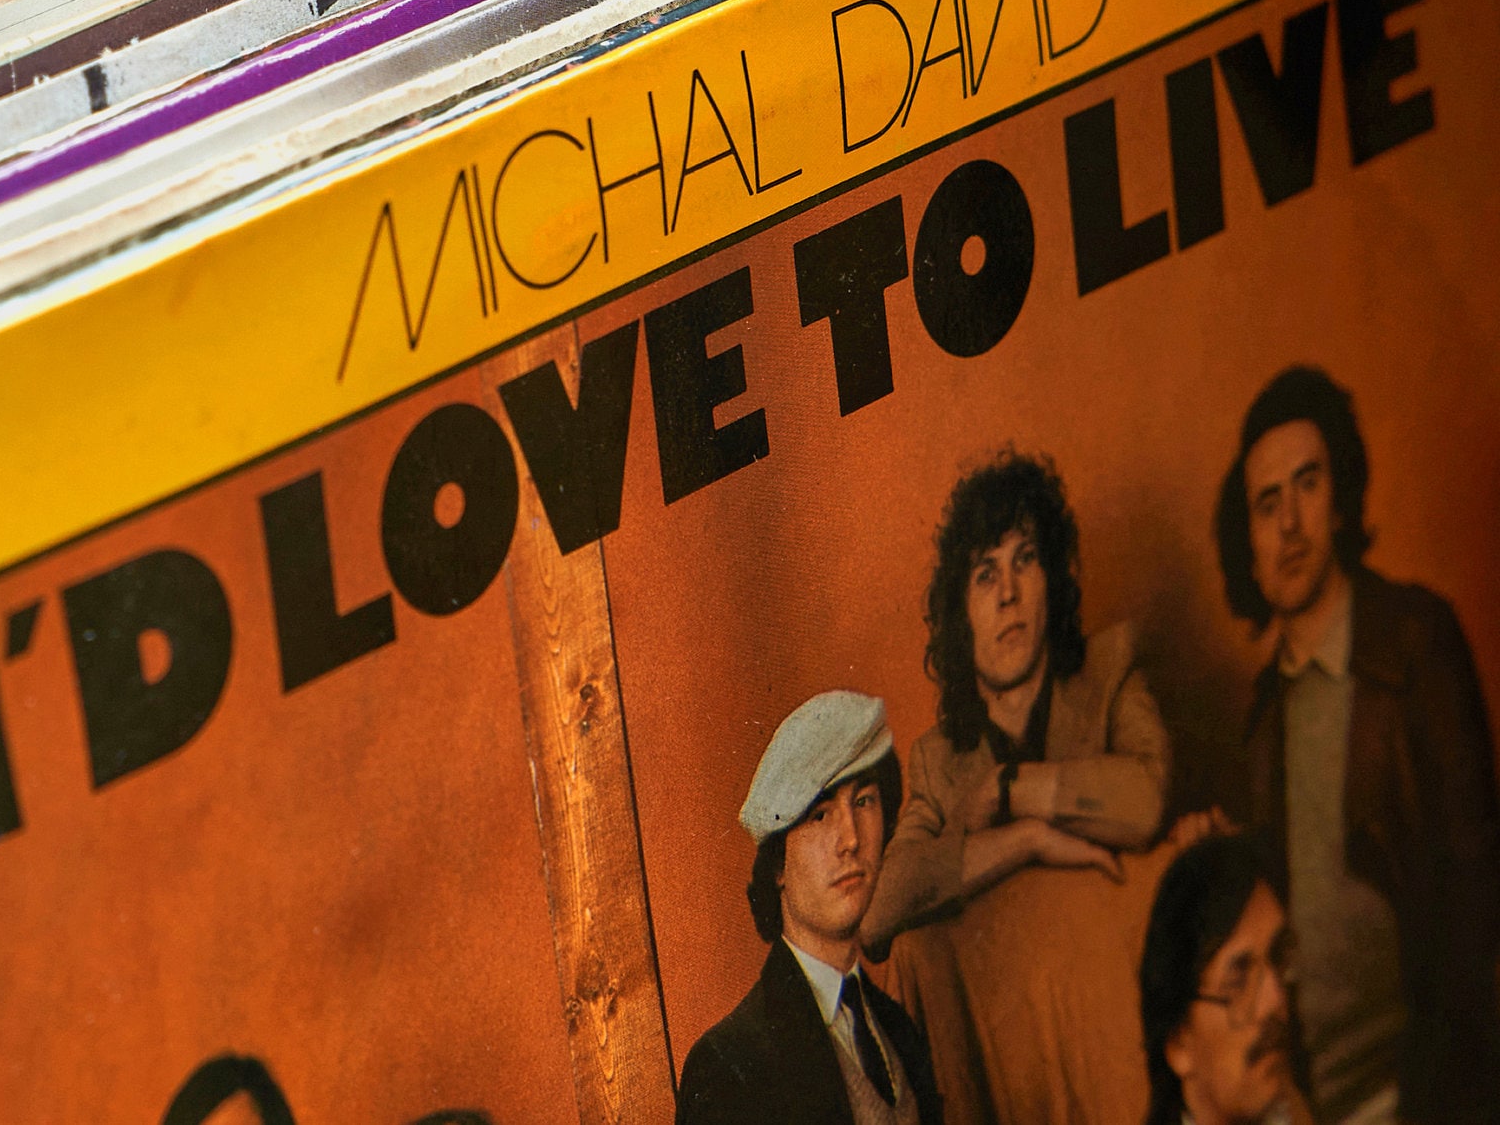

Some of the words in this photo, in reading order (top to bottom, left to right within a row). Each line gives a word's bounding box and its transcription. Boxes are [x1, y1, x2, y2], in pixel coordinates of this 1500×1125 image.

[258, 265, 771, 696] LOVE
[793, 158, 1036, 418] TO
[336, 49, 803, 383] MICHAL
